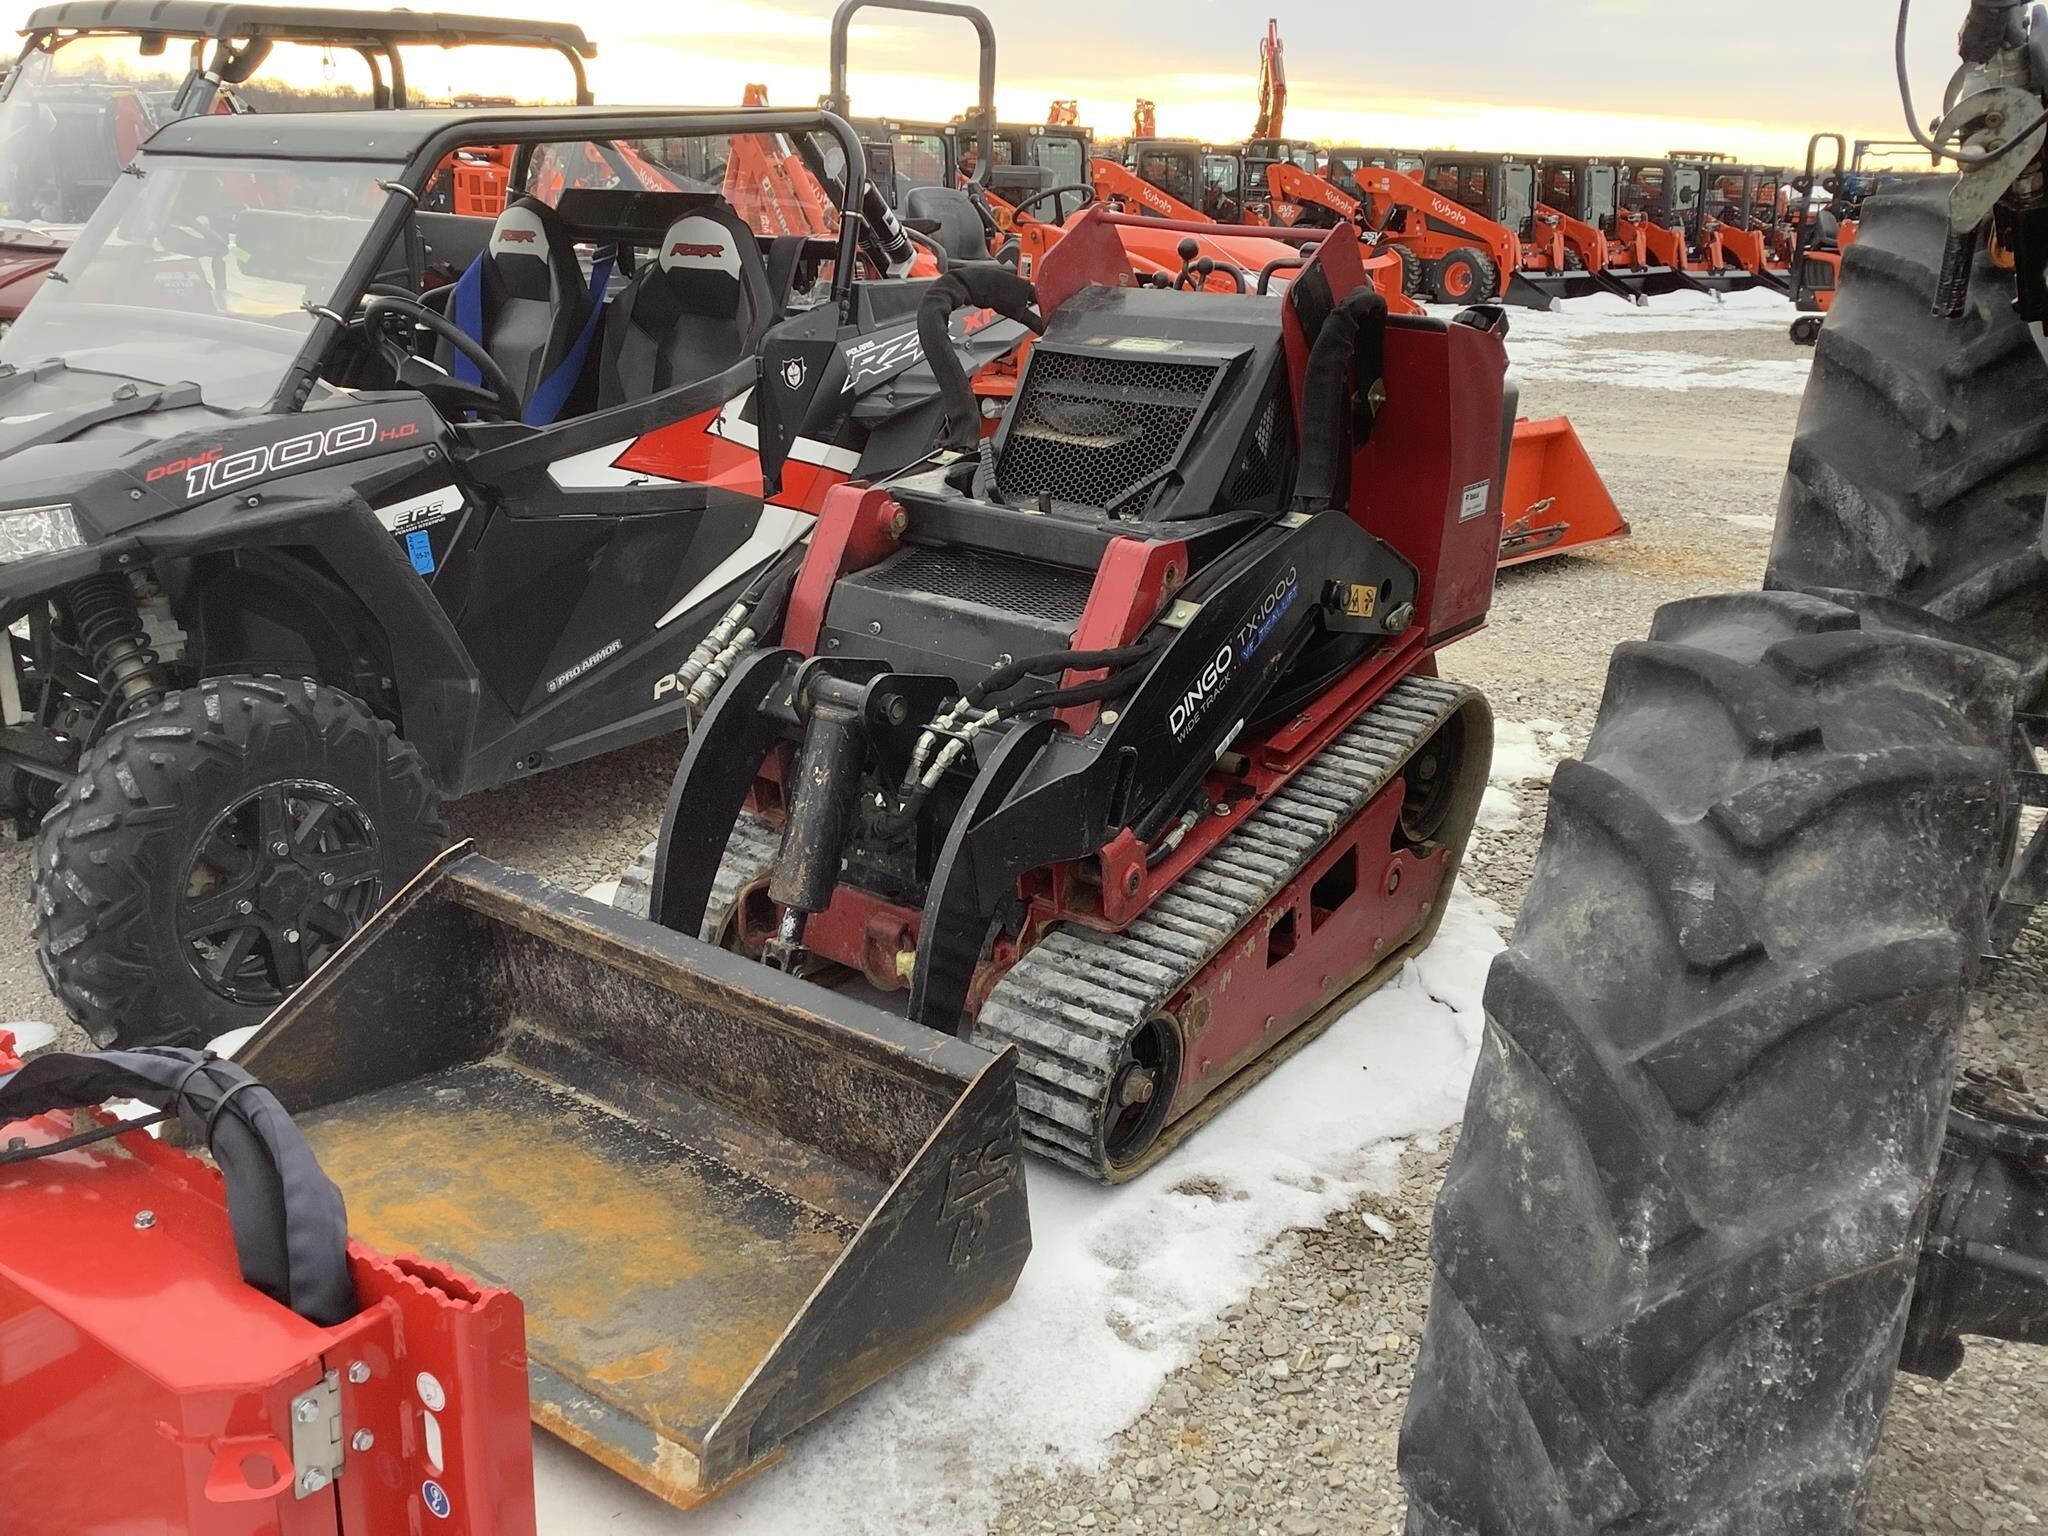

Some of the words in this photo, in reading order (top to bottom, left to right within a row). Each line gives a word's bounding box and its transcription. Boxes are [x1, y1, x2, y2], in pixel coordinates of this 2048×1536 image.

[1143, 187, 1172, 213] Kubota
[1325, 189, 1353, 214] Kubota
[1431, 198, 1466, 225] Kubota
[846, 340, 876, 358] POLARIS
[145, 447, 223, 483] DOHC
[186, 418, 377, 499] 1000
[393, 500, 444, 528] EPS
[559, 666, 581, 686] PRO
[582, 641, 620, 671] ARMOR
[1169, 644, 1232, 735] DINGO
[1177, 711, 1201, 744] WIDE
[1200, 671, 1231, 712] TRACK
